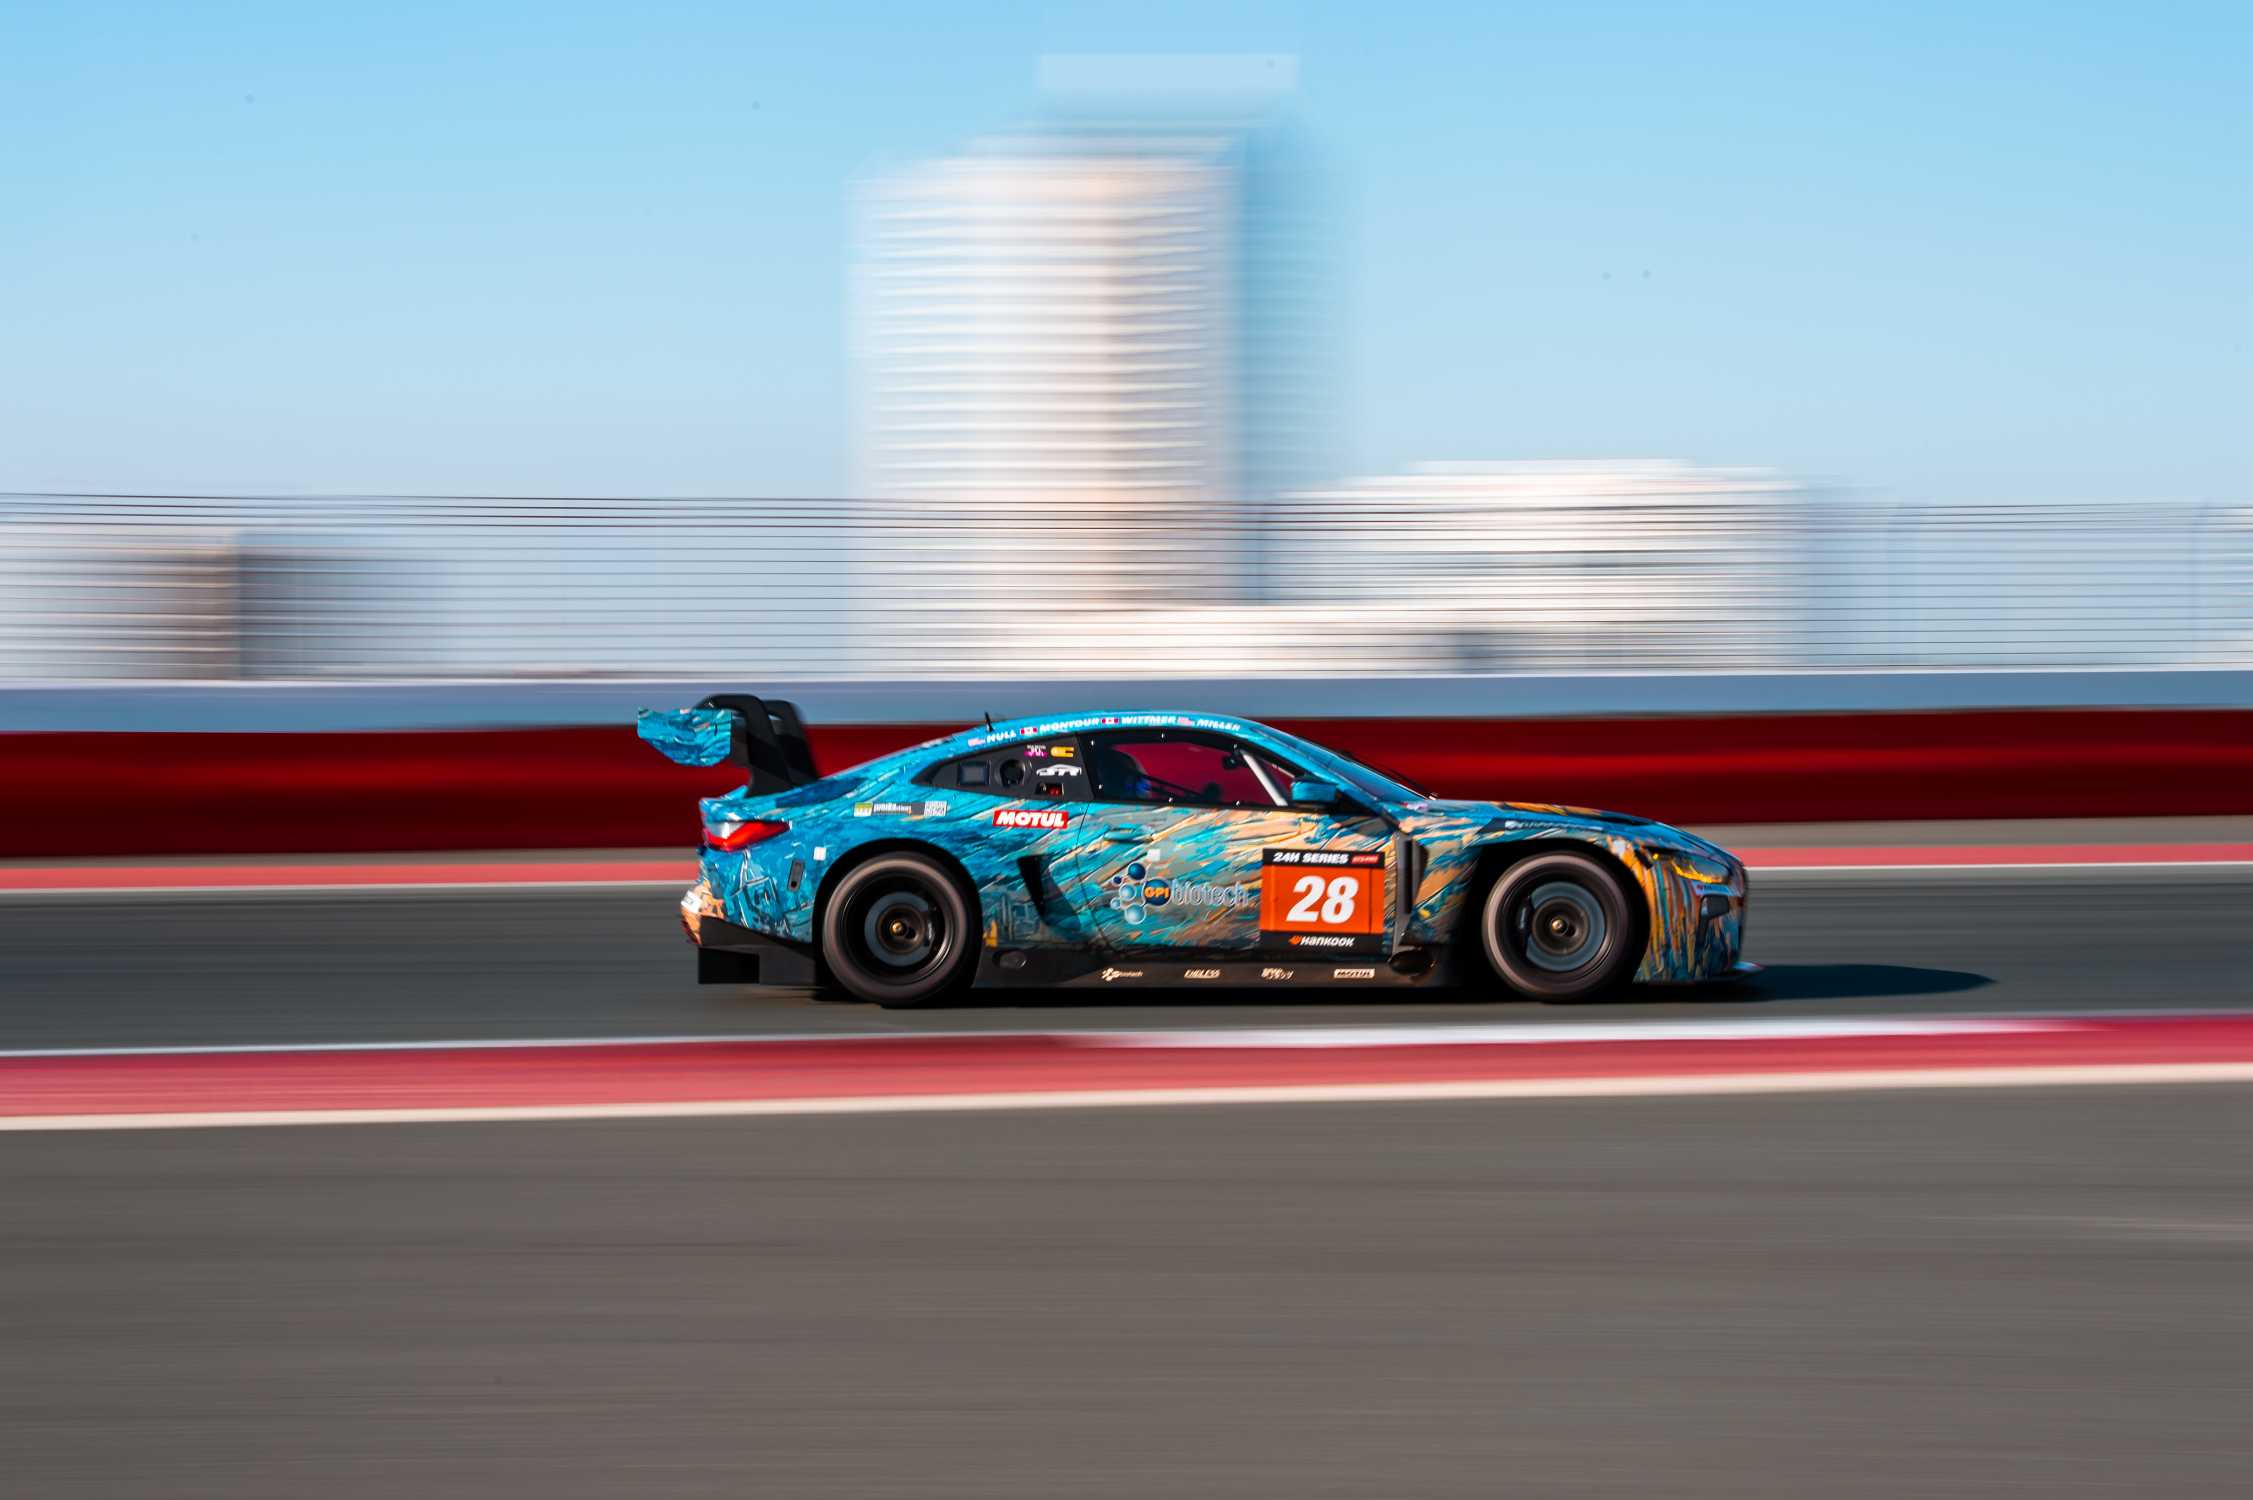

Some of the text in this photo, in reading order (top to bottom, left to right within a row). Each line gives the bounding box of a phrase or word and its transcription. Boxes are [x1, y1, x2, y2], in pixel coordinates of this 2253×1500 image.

[986, 715, 1241, 743] HULL MONTOUR WITTMER MILLER
[995, 811, 1065, 827] MOTUL
[1273, 852, 1301, 863] 24H
[1302, 853, 1349, 864] SERIES
[1144, 879, 1249, 906] GPI biotech
[1286, 875, 1359, 924] 28
